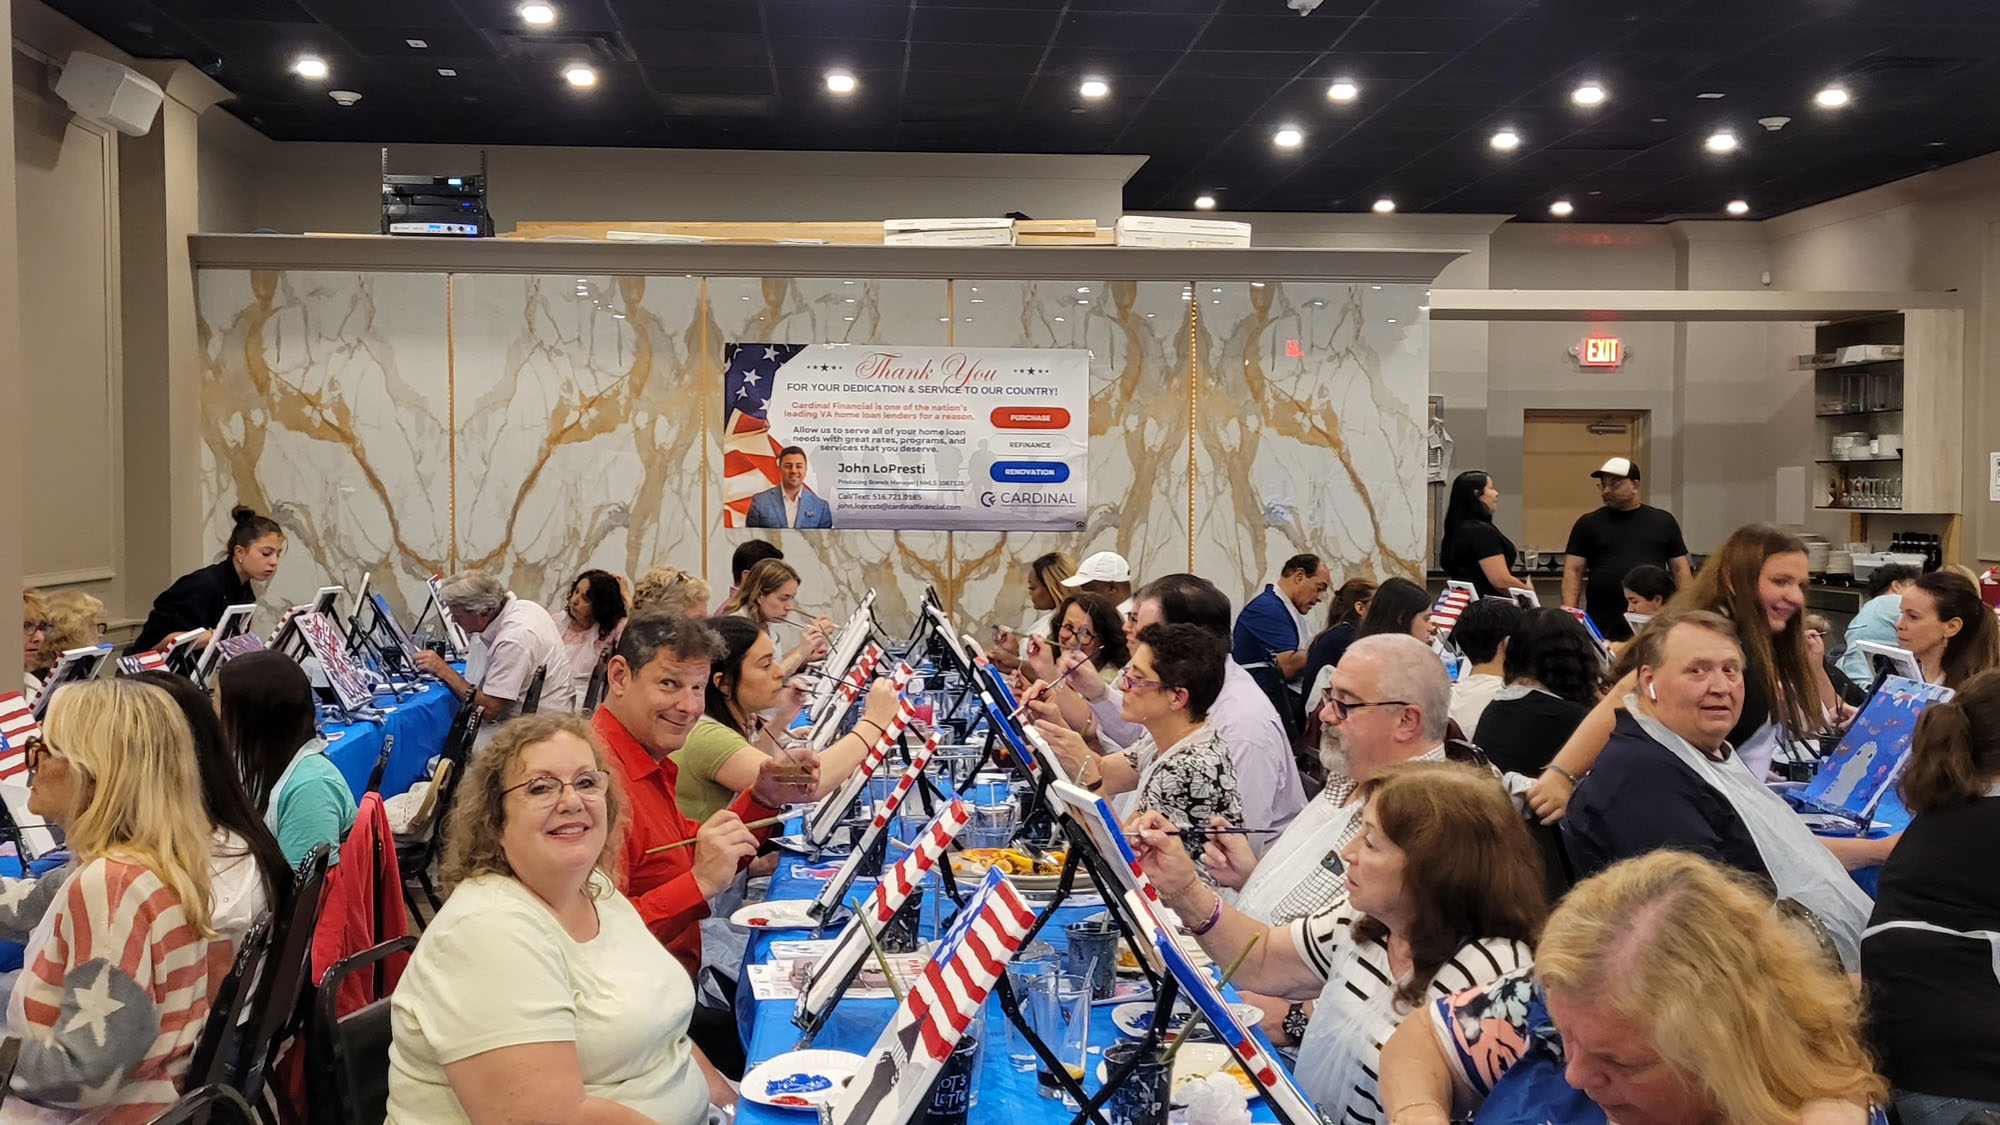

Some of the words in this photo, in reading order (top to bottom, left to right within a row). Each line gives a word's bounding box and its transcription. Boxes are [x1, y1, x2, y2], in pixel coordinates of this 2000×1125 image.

[1587, 338, 1618, 362] EXIT
[855, 352, 934, 380] Thank
[941, 352, 998, 388] You
[787, 383, 808, 391] FOR
[843, 384, 905, 393] DEDICATION
[918, 386, 962, 394] SERVICE
[981, 387, 1003, 395] OUR
[1006, 387, 1058, 396] COUNTRY!
[832, 402, 873, 410] Financial
[784, 410, 817, 419] leading
[883, 411, 917, 419] lenders
[793, 426, 818, 434] Allow
[872, 427, 883, 435] all
[885, 427, 894, 435] of
[896, 429, 917, 437] your
[846, 436, 870, 445] great
[872, 436, 898, 444] rates,
[901, 437, 947, 446] programs,
[860, 444, 879, 452] that
[881, 446, 898, 454] you
[900, 445, 939, 453] deserve.
[838, 463, 870, 473] John
[873, 464, 926, 474] LoPresti
[1004, 468, 1055, 476] RENOVATION
[1000, 492, 1077, 504] CARDINAL
